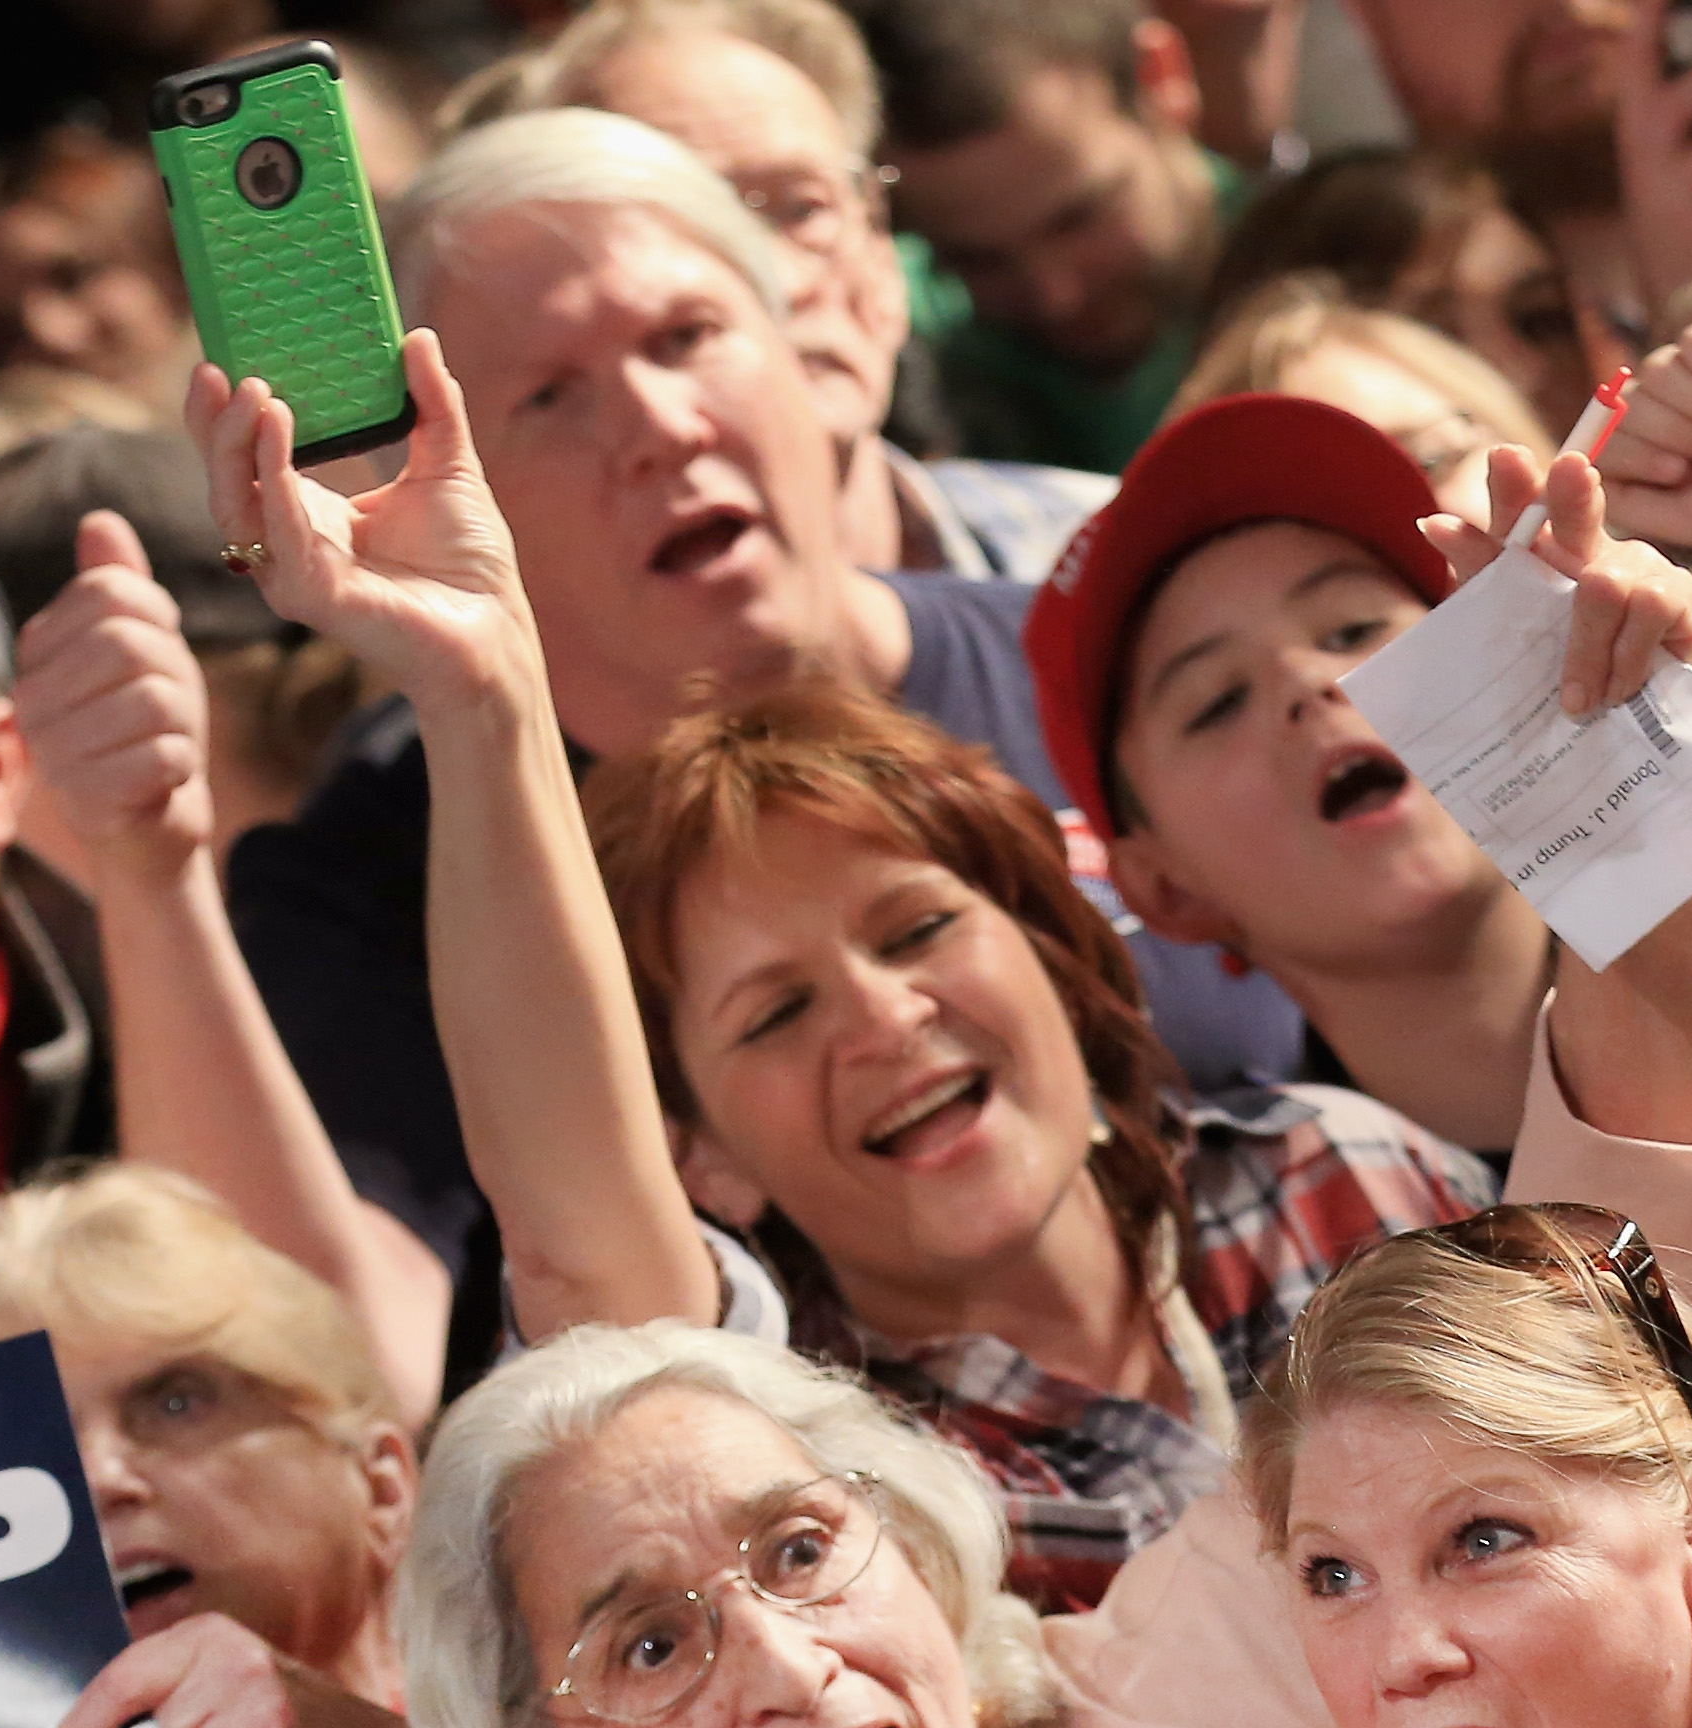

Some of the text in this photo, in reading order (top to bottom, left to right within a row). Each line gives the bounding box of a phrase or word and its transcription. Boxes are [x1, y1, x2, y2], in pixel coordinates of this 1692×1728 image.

[1517, 759, 1661, 881] Donald J. Trump in
